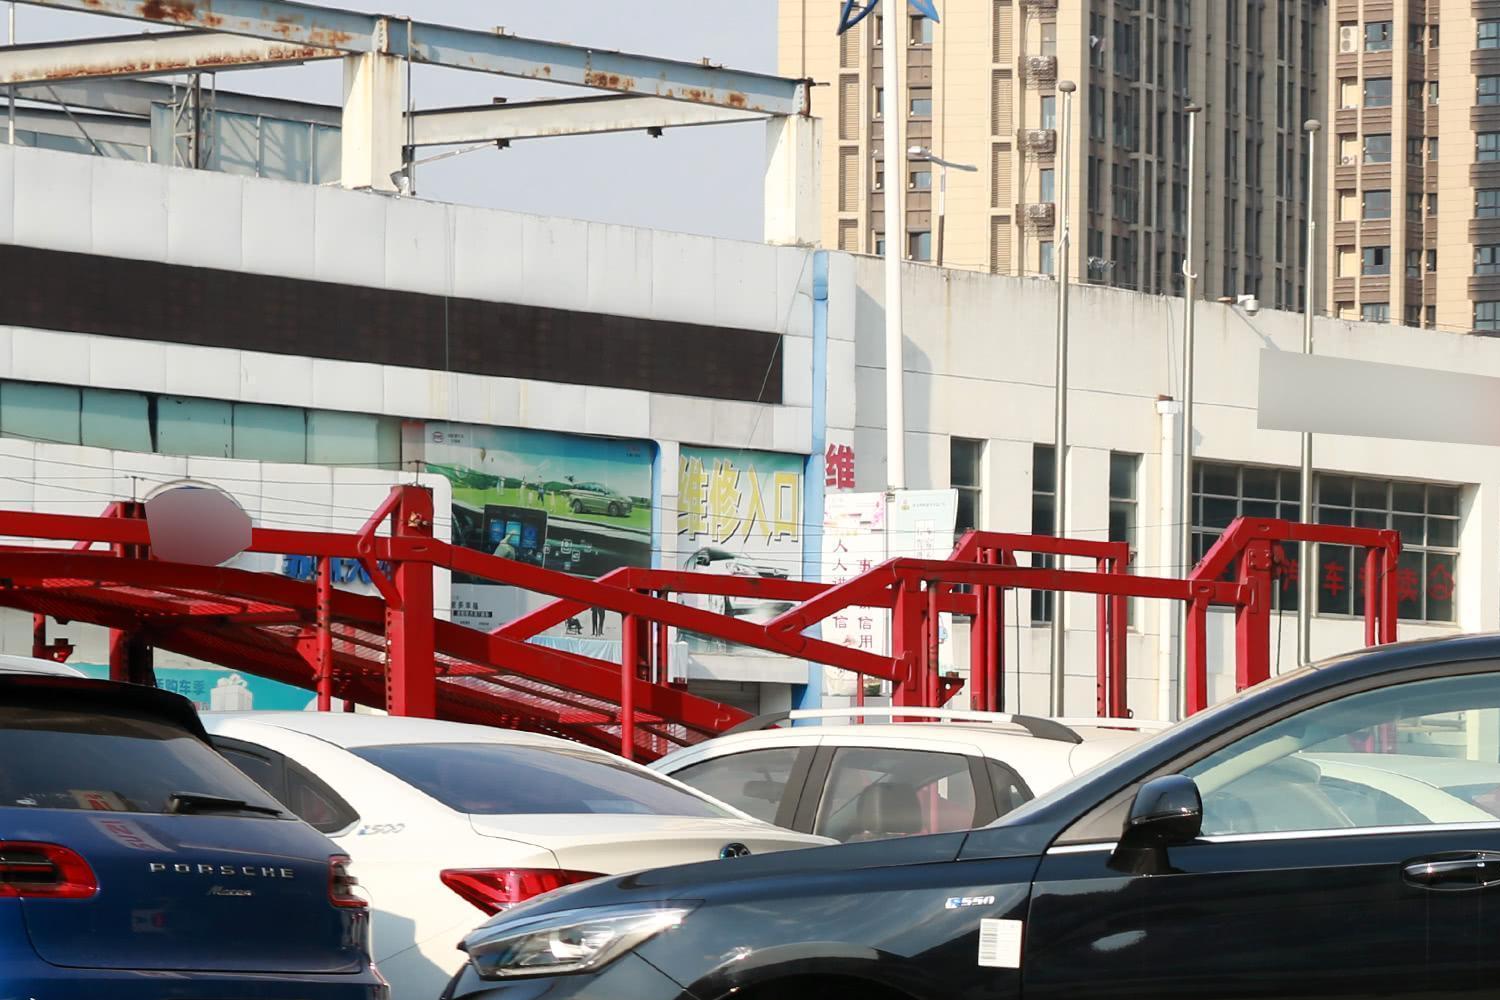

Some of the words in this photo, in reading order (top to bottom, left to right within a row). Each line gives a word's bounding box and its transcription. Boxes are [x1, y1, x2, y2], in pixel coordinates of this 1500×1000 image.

[825, 443, 856, 489] 维
[678, 455, 800, 545] 维修入口
[149, 862, 295, 878] PORSCHE
